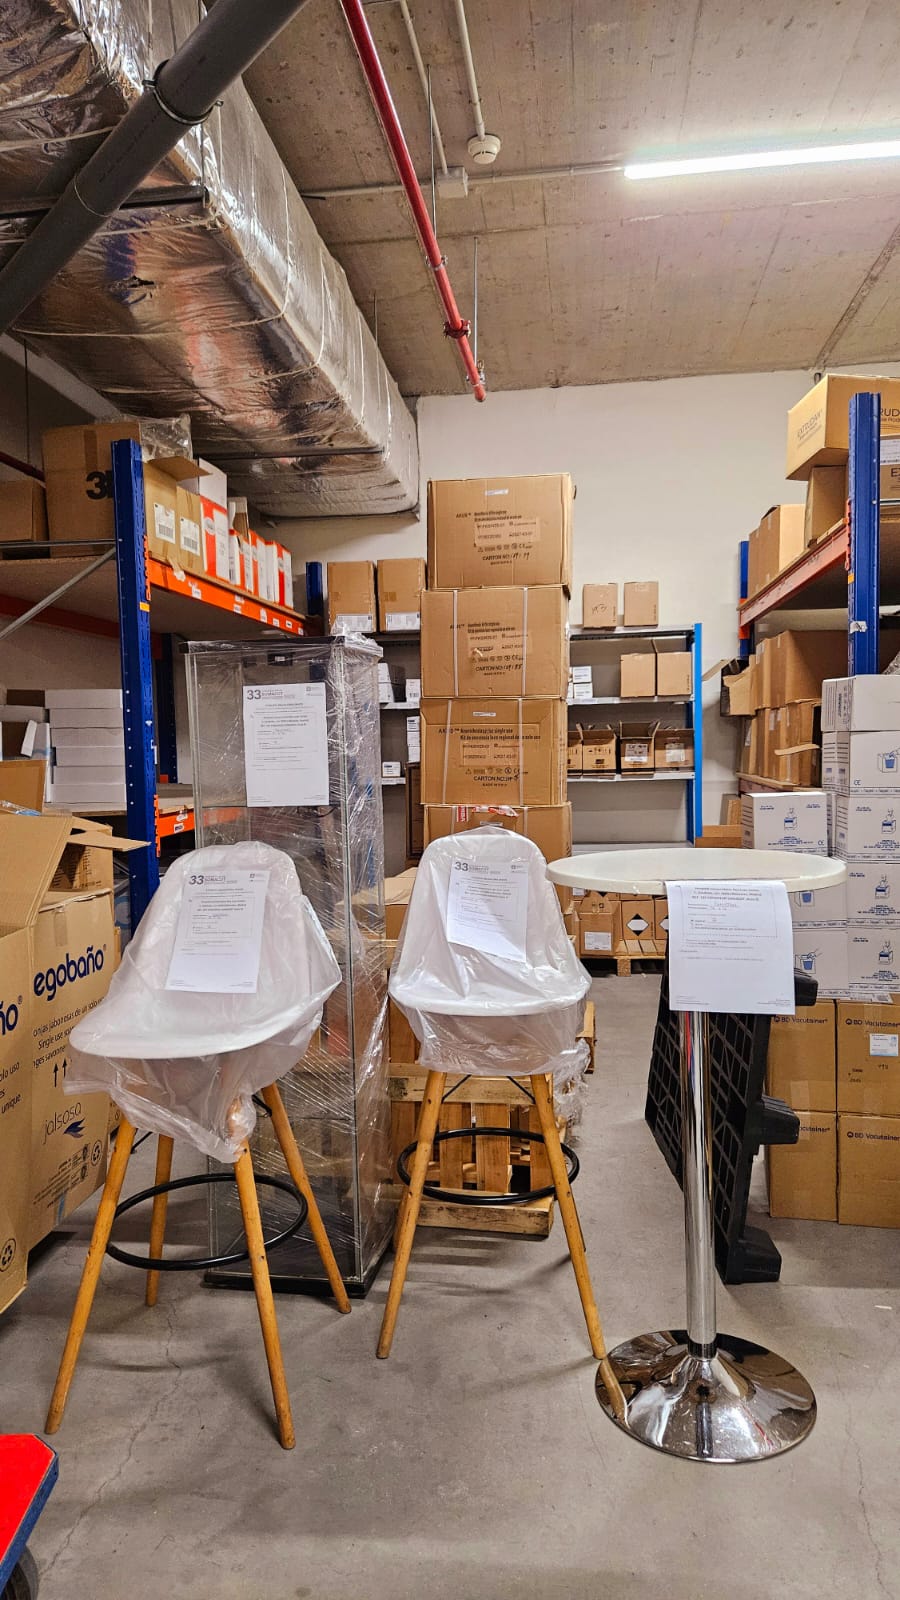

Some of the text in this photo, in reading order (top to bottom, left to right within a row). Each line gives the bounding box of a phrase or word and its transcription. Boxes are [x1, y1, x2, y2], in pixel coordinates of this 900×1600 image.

[86, 471, 113, 500] 3
[247, 689, 261, 700] 33
[454, 861, 469, 872] 33
[188, 874, 205, 885] 33
[38, 1036, 54, 1050] Single
